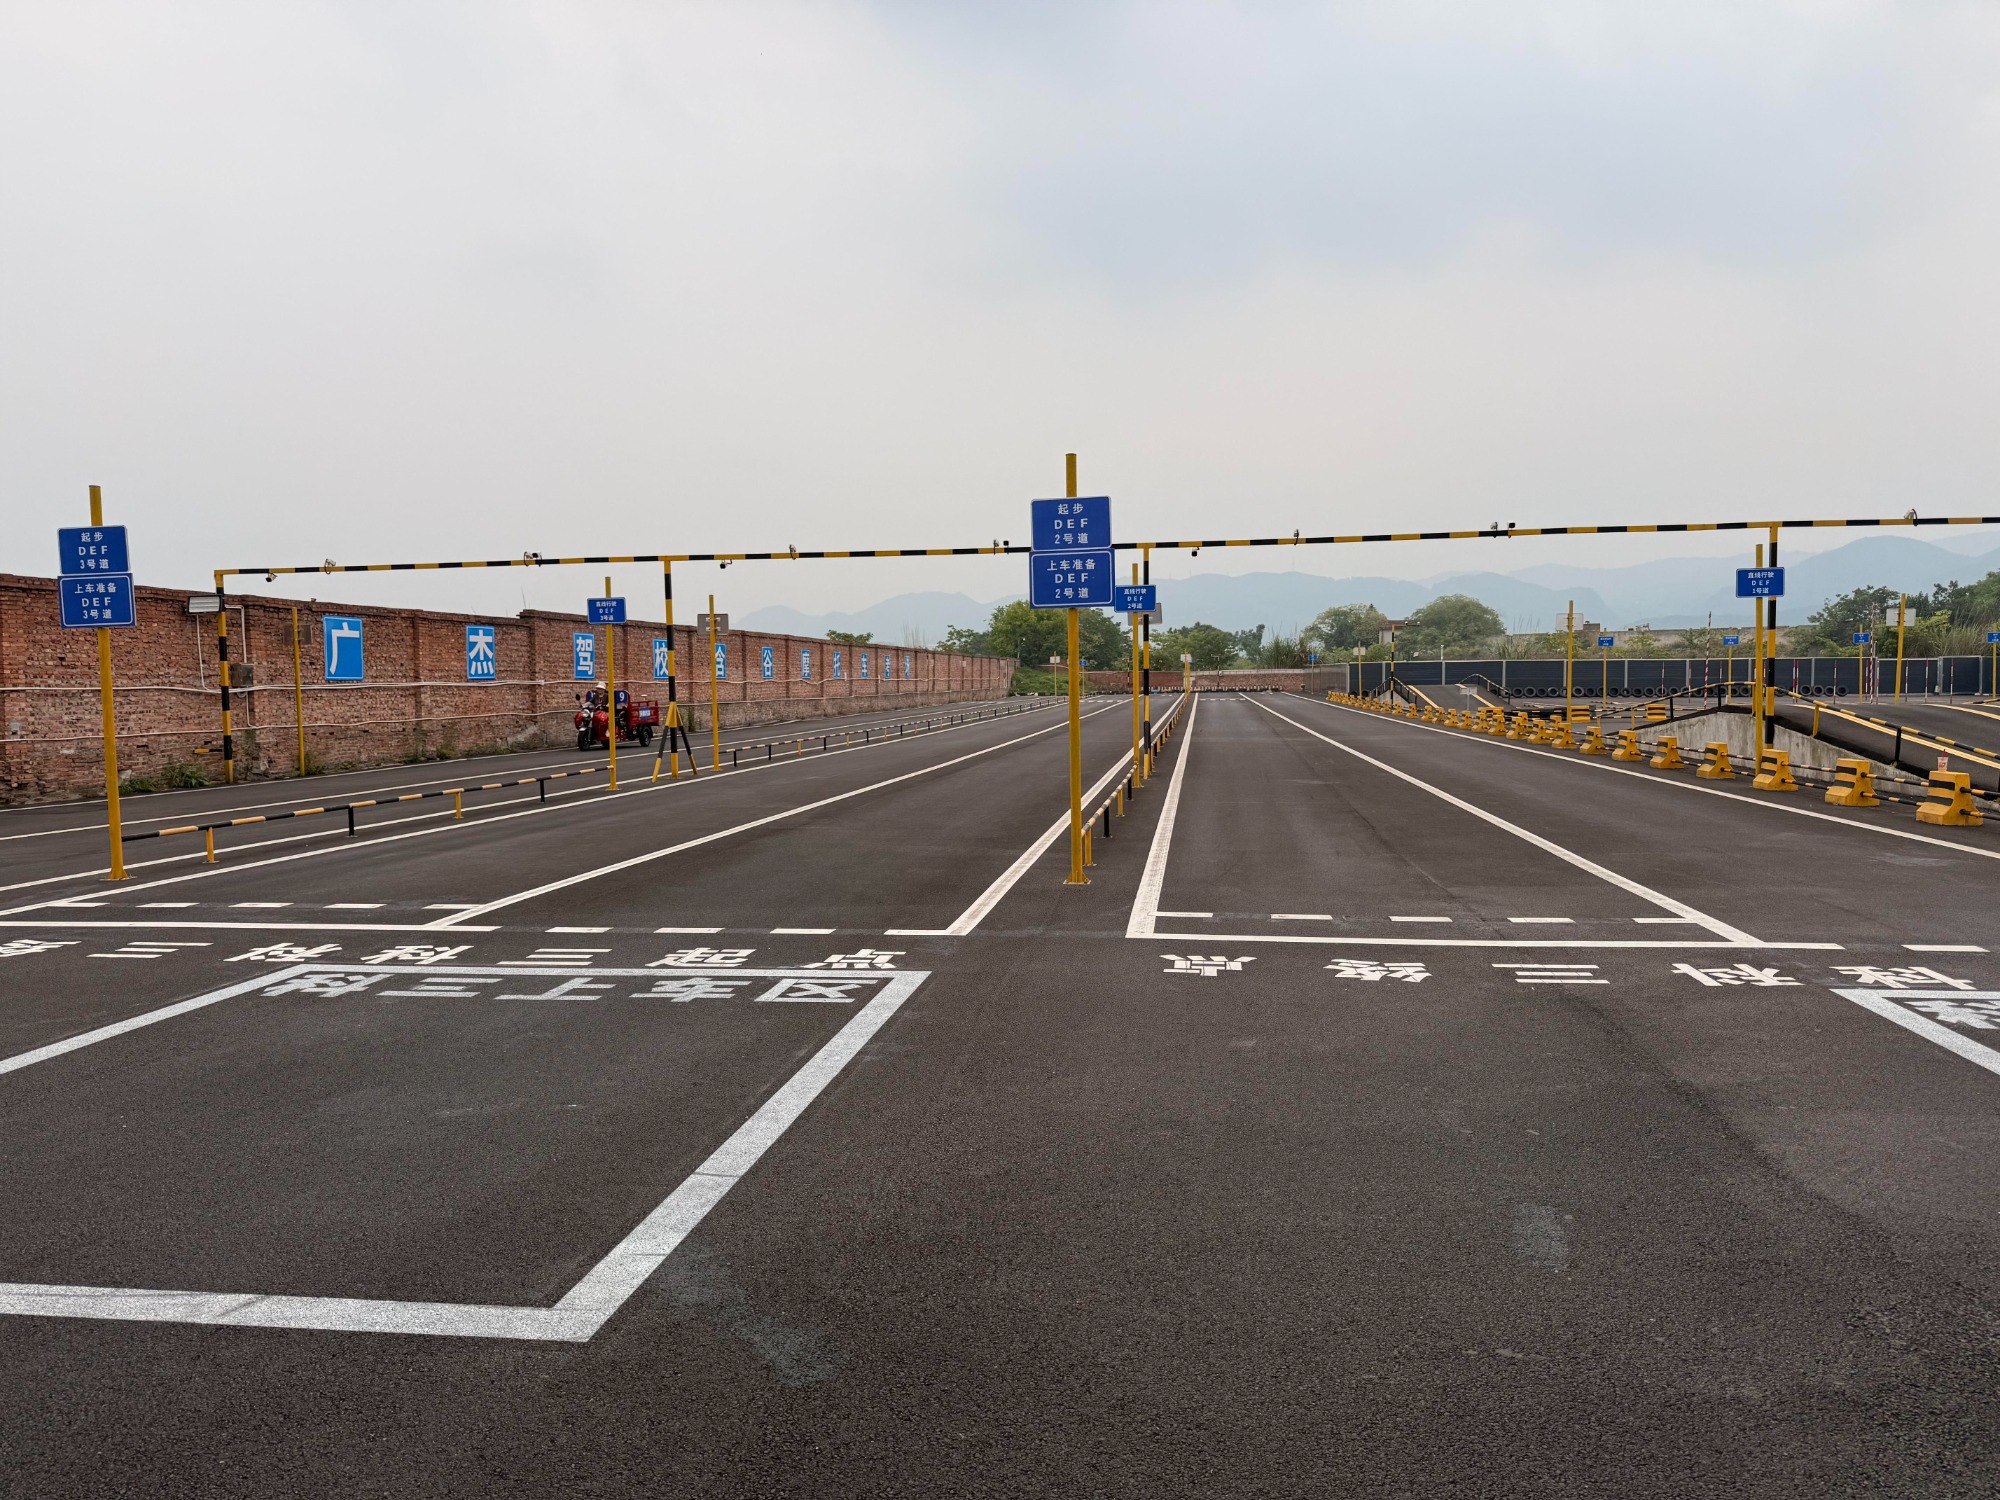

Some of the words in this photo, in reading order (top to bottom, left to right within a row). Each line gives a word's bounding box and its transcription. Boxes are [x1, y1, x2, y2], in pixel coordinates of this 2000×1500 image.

[1057, 503, 1084, 515] 起步
[81, 531, 104, 543] 起步
[1054, 532, 1089, 544] 2号道
[79, 558, 110, 570] 3号道
[1046, 558, 1096, 571] 上车准备
[74, 582, 117, 594] 上车准备
[1055, 587, 1089, 599] 2号道
[82, 609, 113, 620] 3号道
